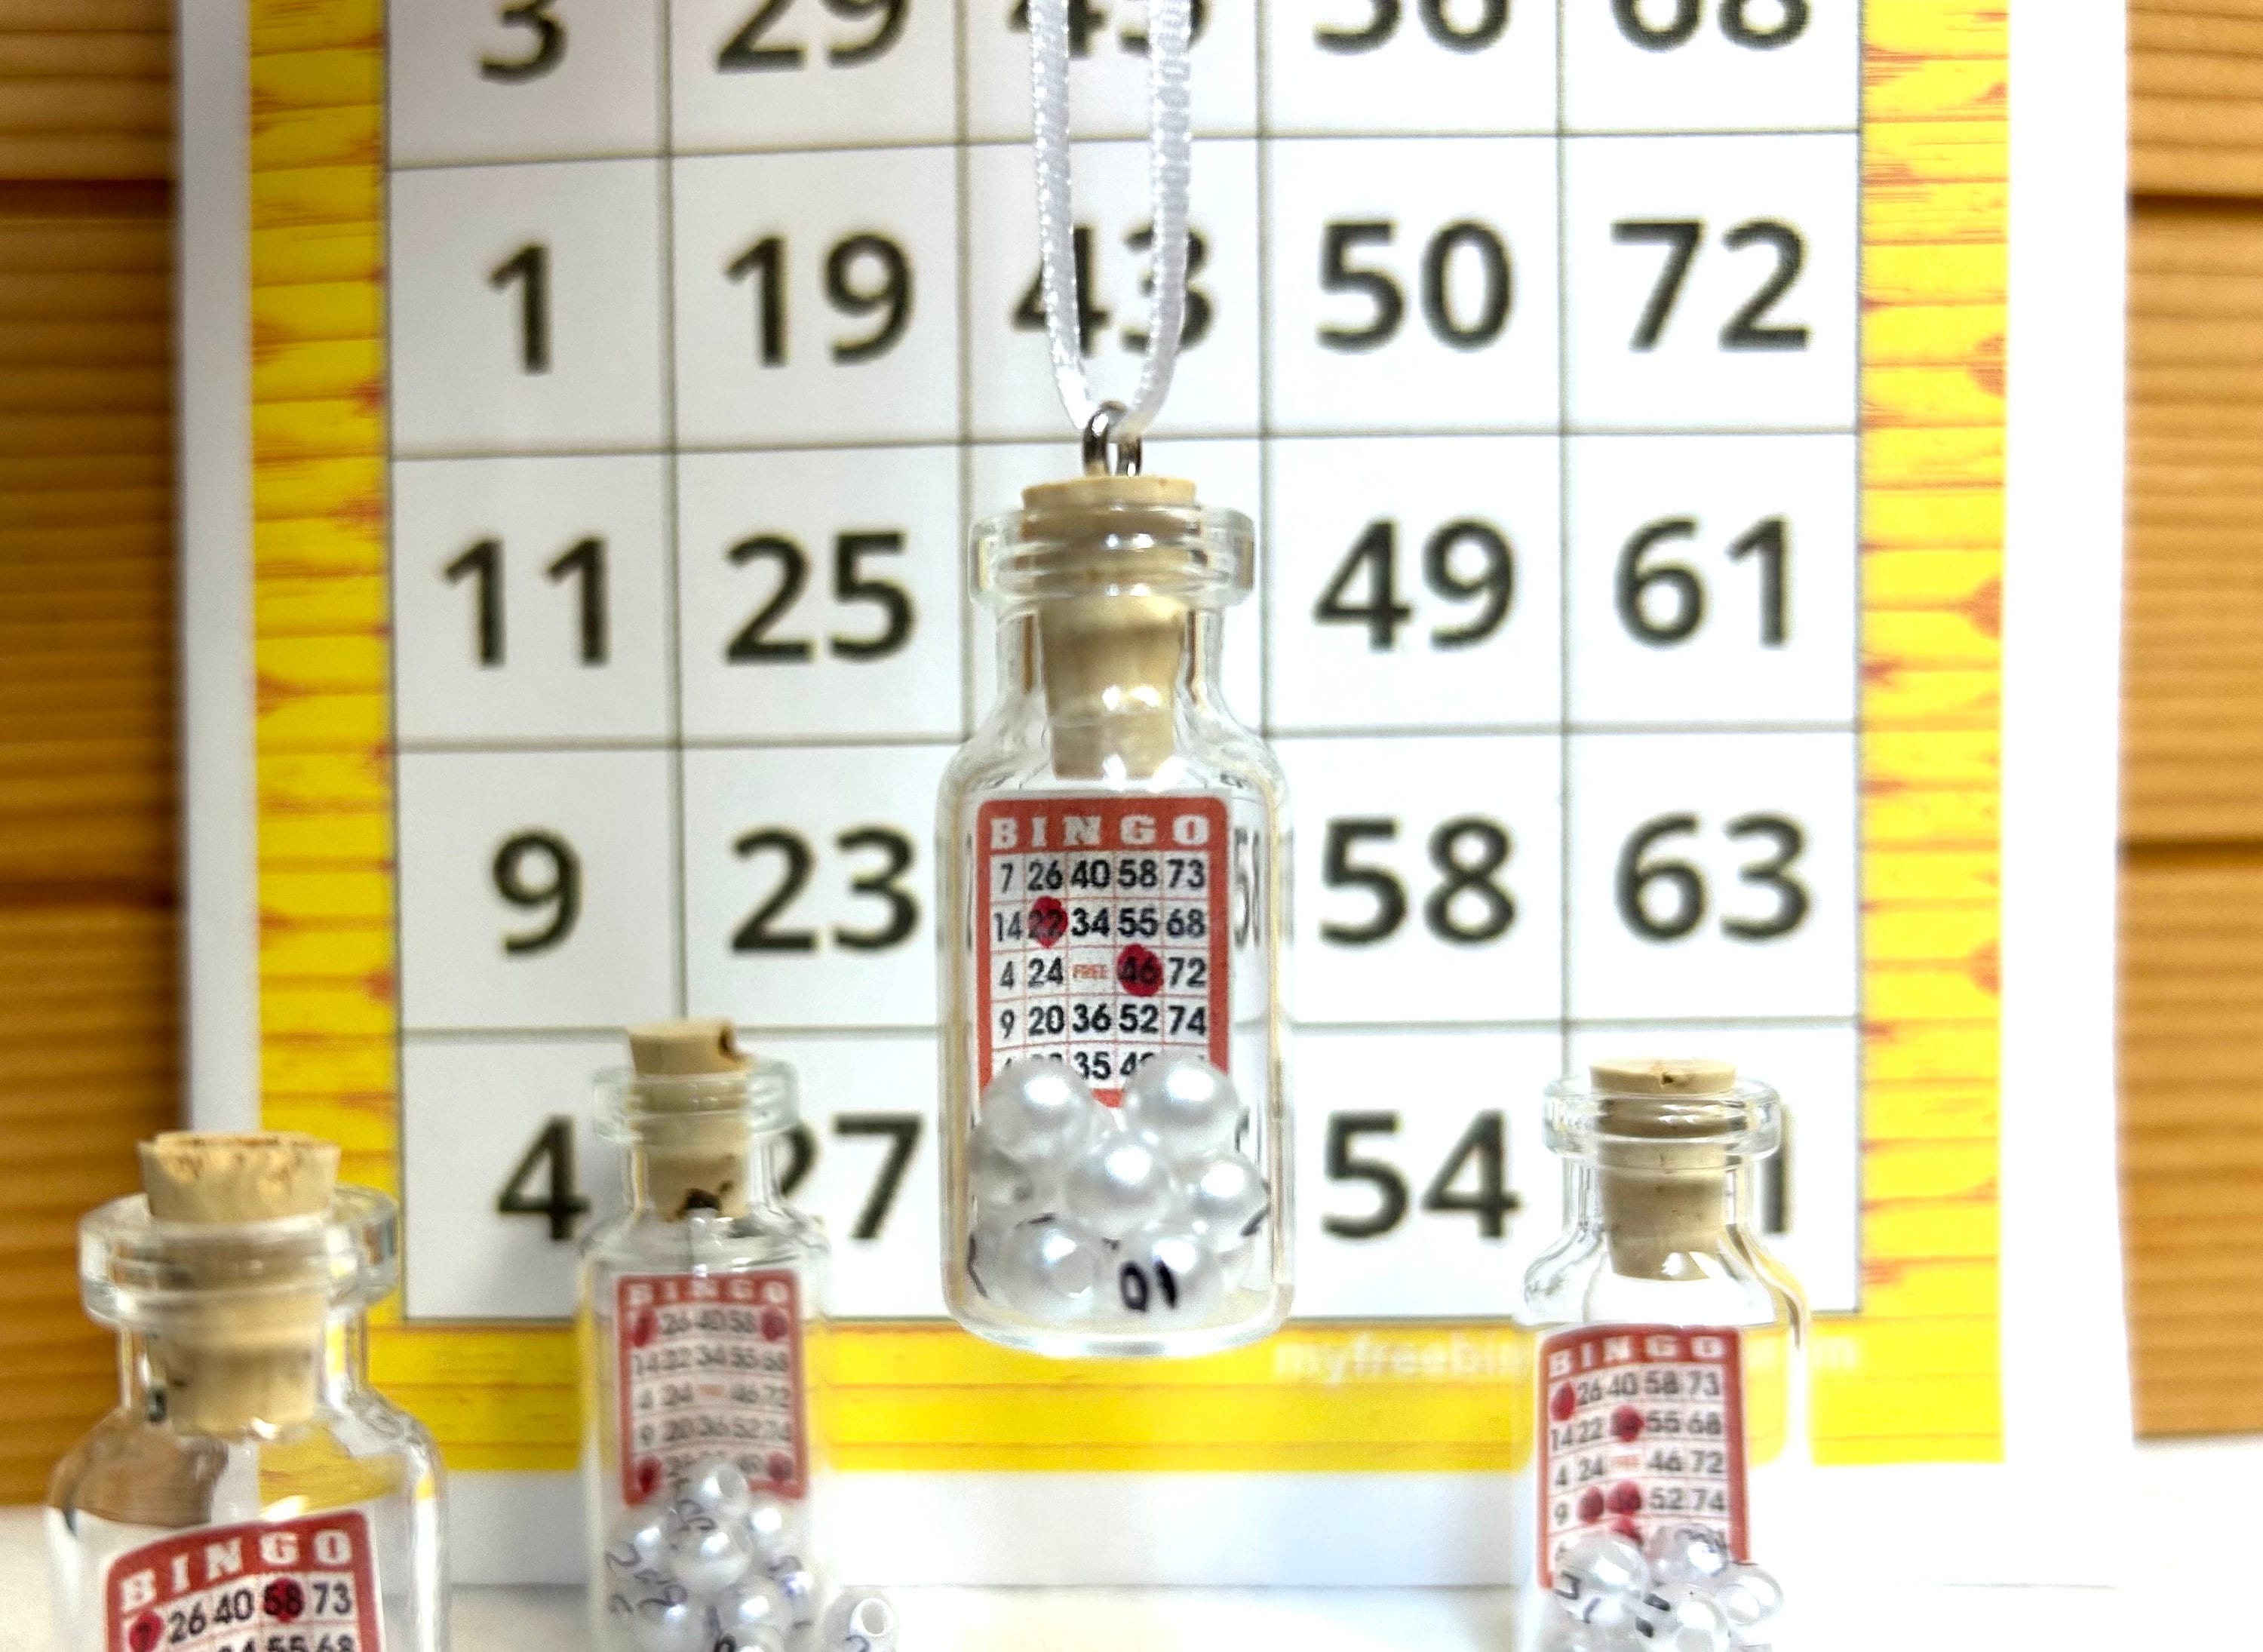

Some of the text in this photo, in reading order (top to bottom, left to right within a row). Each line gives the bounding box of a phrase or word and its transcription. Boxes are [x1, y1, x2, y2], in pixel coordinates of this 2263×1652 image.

[488, 220, 1809, 375] 1 19 43 50 72
[443, 518, 1786, 668] 11 25 49 61
[990, 814, 1208, 849] BINGO
[490, 829, 582, 957] 9
[729, 826, 920, 956] 23
[1322, 818, 1516, 947] 58
[1619, 815, 1810, 942] 63
[999, 858, 1206, 894] 7 26 40 58 73
[994, 911, 1022, 942] 14
[1070, 907, 1110, 938] 34
[1116, 907, 1159, 938] 55
[1166, 908, 1206, 938] 68
[999, 961, 1015, 990] 4
[1027, 957, 1064, 987] 24
[1118, 956, 1157, 984] 46
[1168, 957, 1206, 988] 72
[999, 1003, 1206, 1039] 9 20 36 52 74
[495, 1116, 594, 1248] 4
[1325, 1113, 1521, 1241] 54
[1549, 1334, 1724, 1376] BINGO
[1607, 1371, 1638, 1396] 40
[1645, 1370, 1679, 1395] 58
[1688, 1371, 1719, 1396] 73
[1550, 1429, 1573, 1451] 14
[1646, 1410, 1680, 1434] 55
[1688, 1411, 1721, 1435] 68
[1555, 1464, 1568, 1486] 4
[1690, 1450, 1723, 1474] 72
[1650, 1487, 1684, 1510] 52
[1692, 1488, 1725, 1510] 74
[119, 1528, 353, 1613] BINGO
[168, 1601, 207, 1644] 26
[213, 1588, 254, 1624] 40
[312, 1581, 352, 1614] 73
